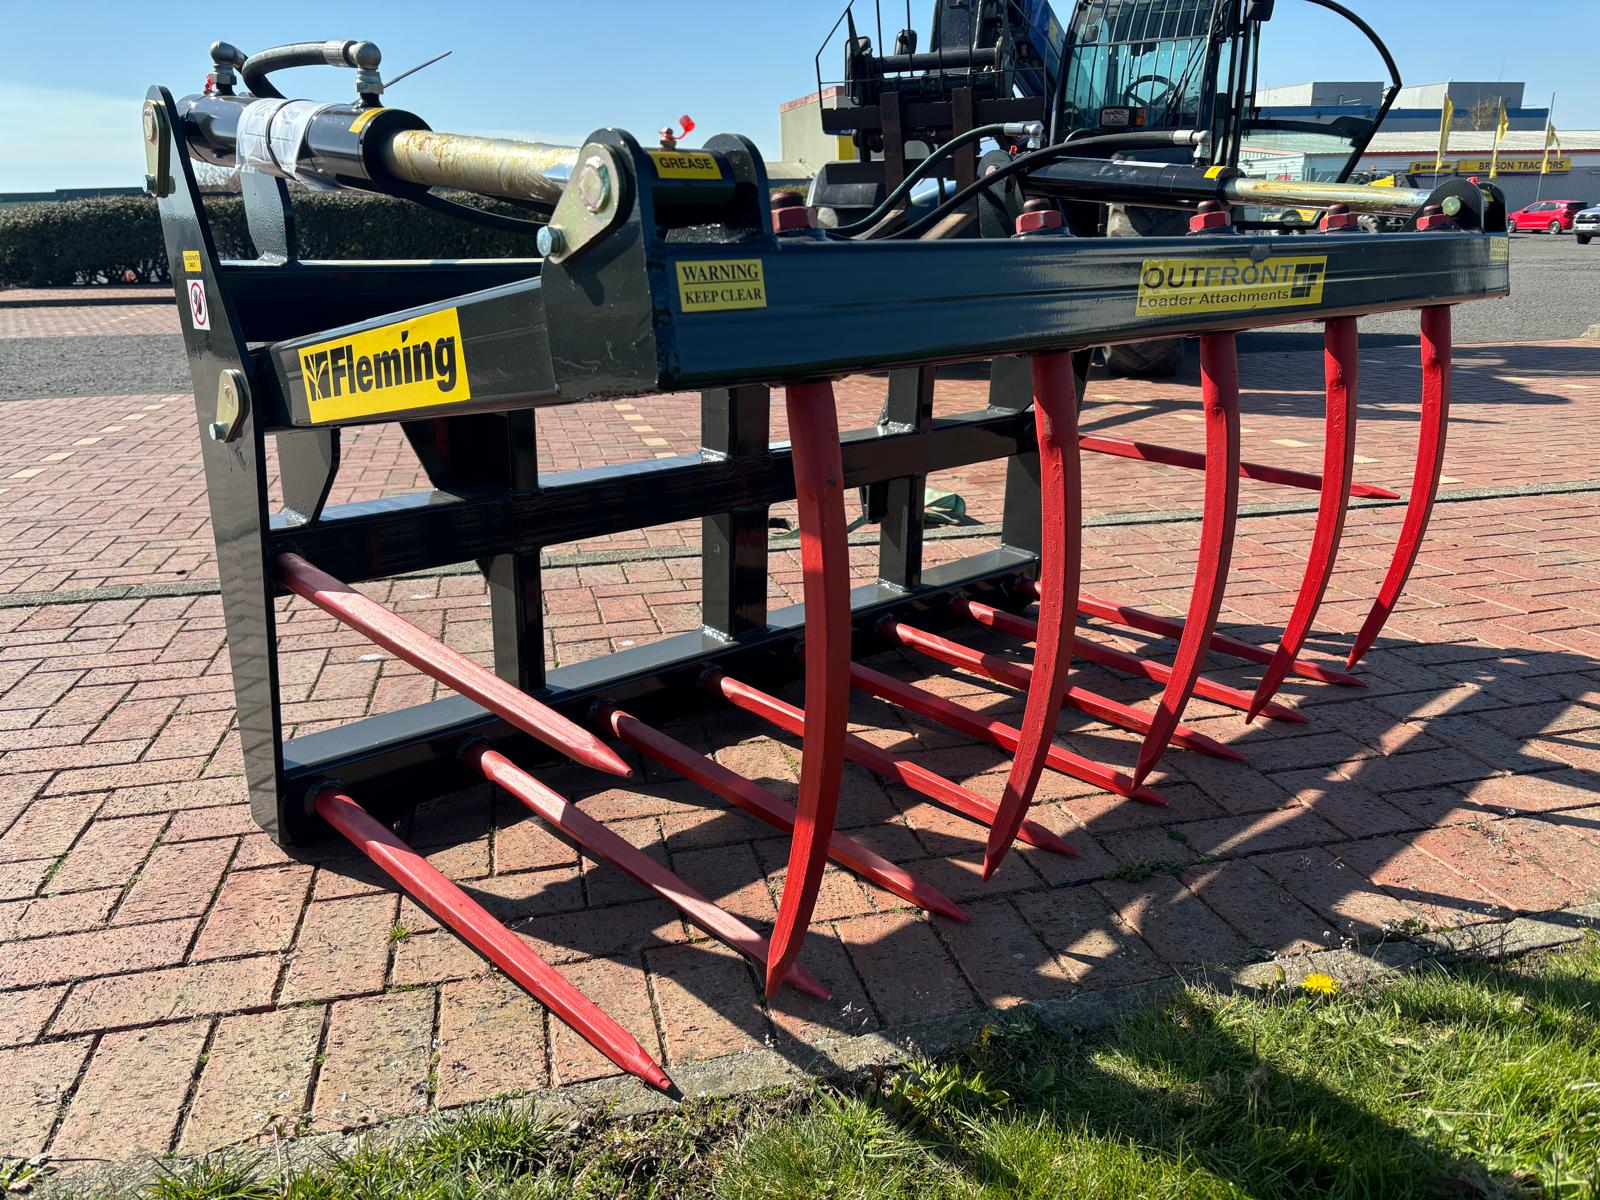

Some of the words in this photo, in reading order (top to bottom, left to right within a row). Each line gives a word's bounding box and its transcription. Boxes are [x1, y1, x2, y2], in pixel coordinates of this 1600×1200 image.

[659, 156, 714, 170] GREASE
[1478, 161, 1514, 170] BRSON
[682, 264, 759, 282] WARNING
[1142, 264, 1295, 289] OUTFRONT
[685, 290, 719, 304] KEEP
[721, 288, 762, 302] CLEAR
[1138, 295, 1195, 308] Loader
[1199, 290, 1289, 304] Attachments
[329, 330, 458, 397] Fleming
